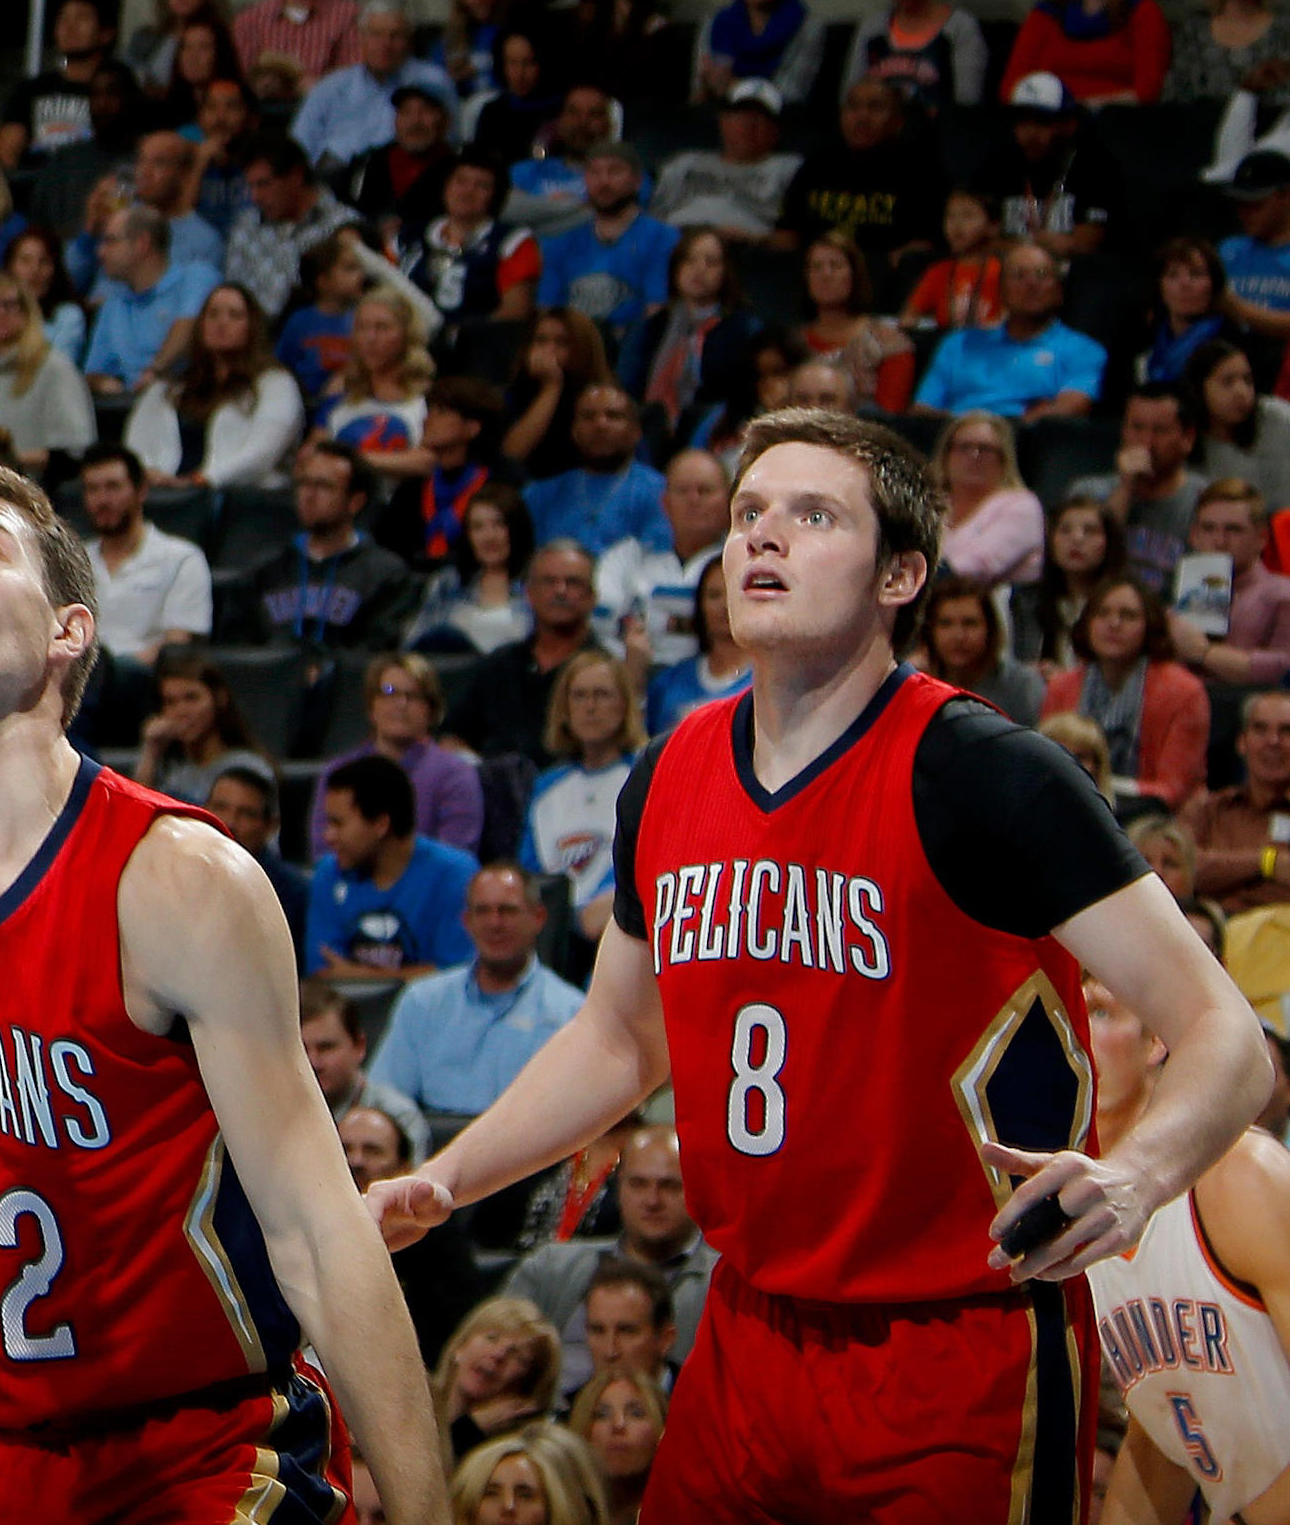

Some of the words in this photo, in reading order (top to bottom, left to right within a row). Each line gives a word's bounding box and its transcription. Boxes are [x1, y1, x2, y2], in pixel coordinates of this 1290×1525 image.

[652, 859, 891, 981] PELICANS
[726, 1001, 788, 1157] 8
[1164, 1391, 1223, 1483] 5
